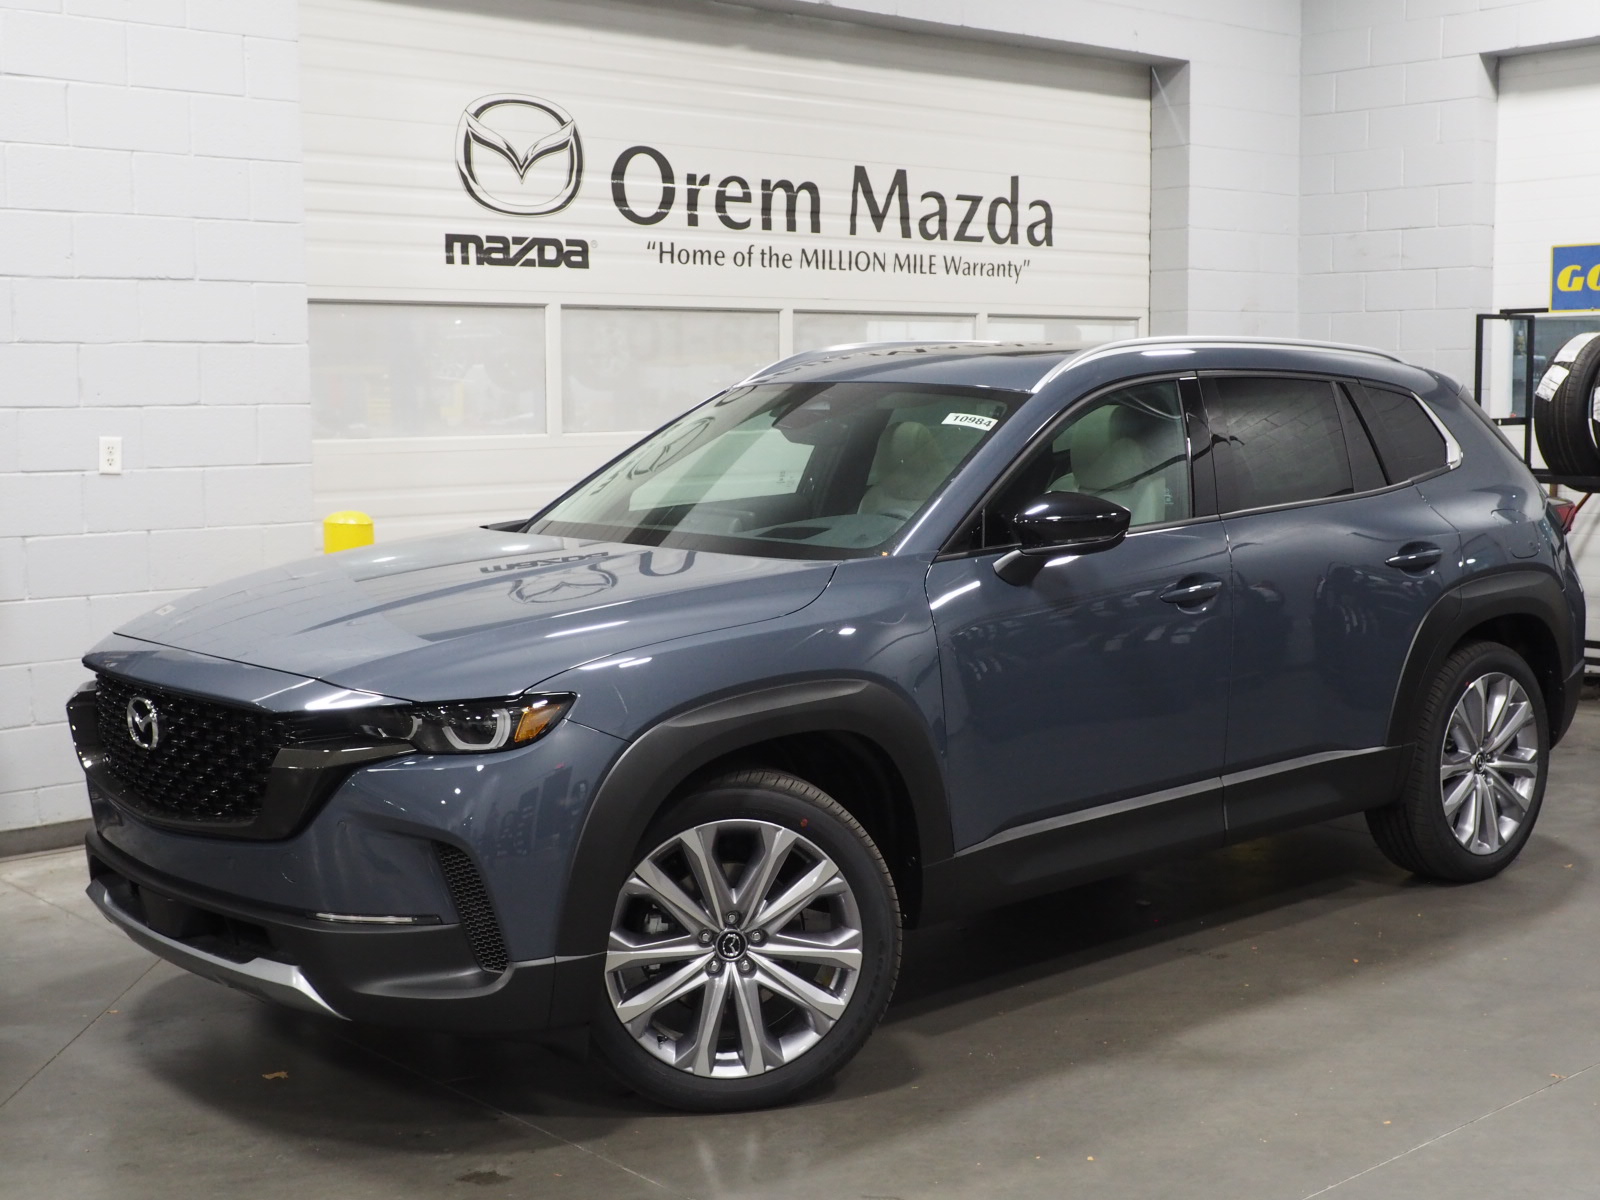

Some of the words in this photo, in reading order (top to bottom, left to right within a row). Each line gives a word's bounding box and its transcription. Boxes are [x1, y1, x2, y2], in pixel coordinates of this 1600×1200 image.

[611, 145, 821, 233] Orem
[849, 165, 1054, 247] Mazda
[647, 241, 726, 266] “Home
[733, 245, 755, 268] of
[760, 246, 793, 269] the
[800, 248, 886, 273] MILLION
[893, 253, 937, 275] MILE
[943, 255, 1030, 284] Warranty”
[953, 415, 993, 427] 10984
